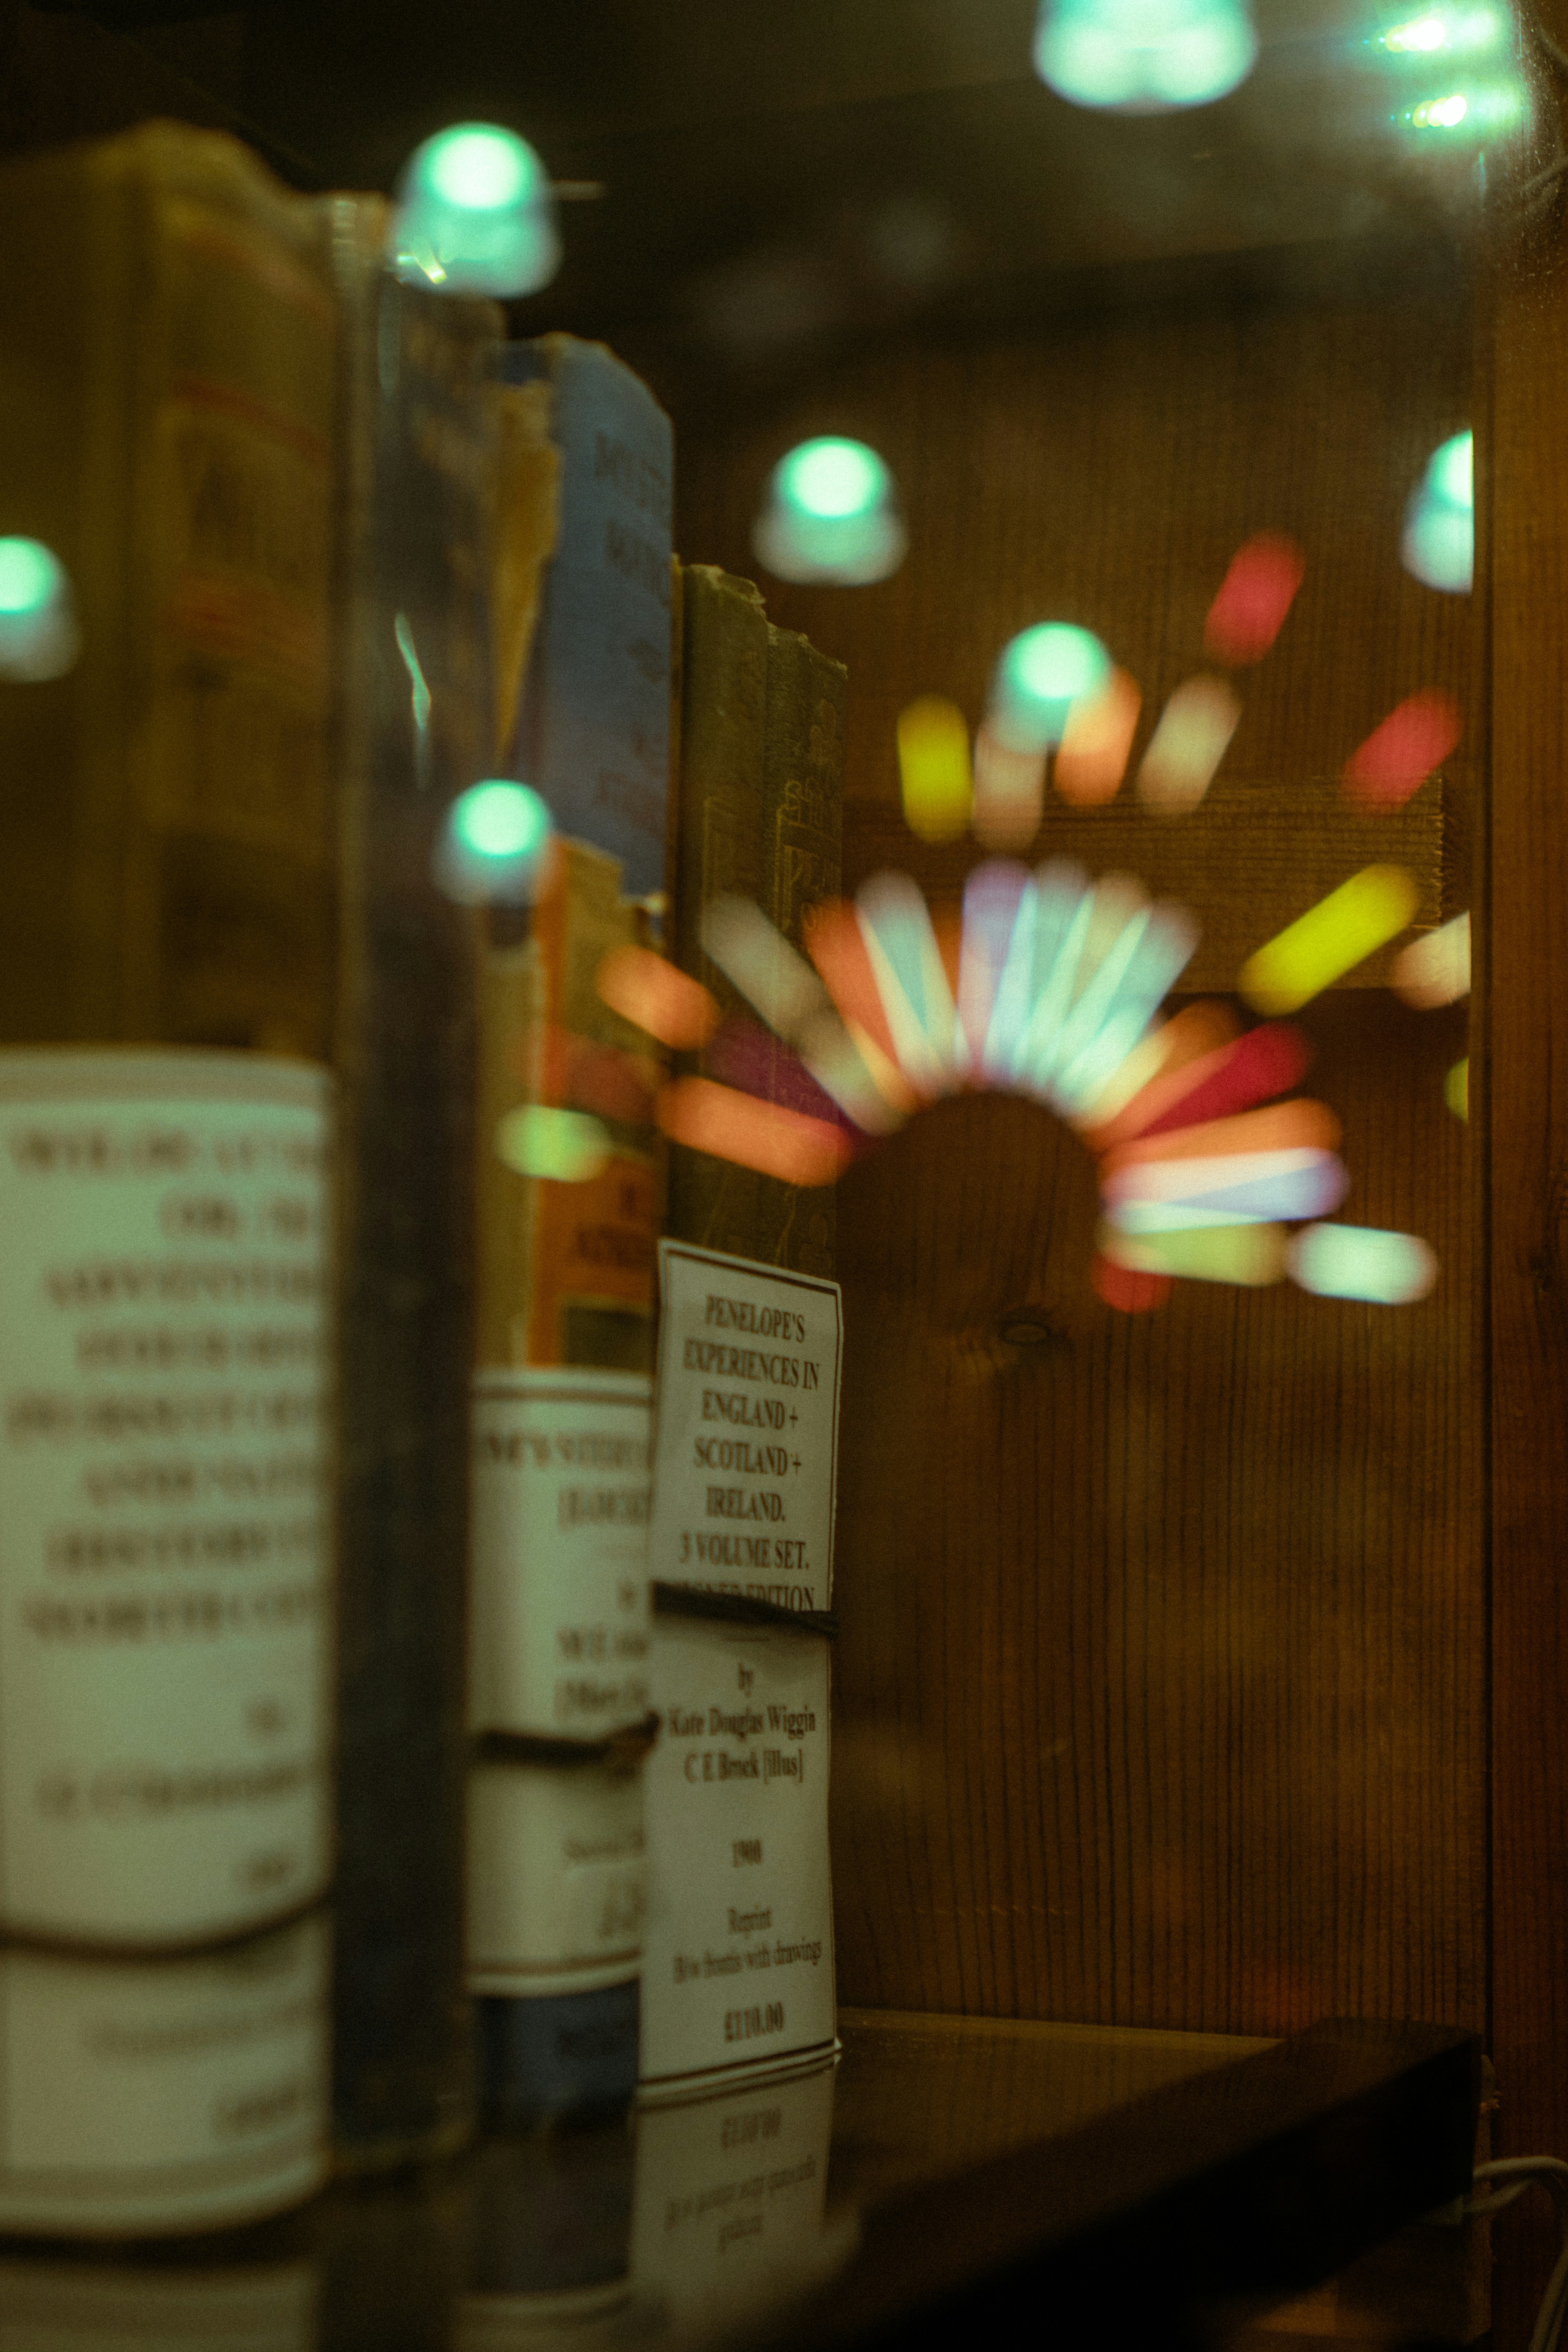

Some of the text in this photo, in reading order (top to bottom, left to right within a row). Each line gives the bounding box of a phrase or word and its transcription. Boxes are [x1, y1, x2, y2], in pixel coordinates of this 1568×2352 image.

[705, 1294, 805, 1343] PENELOPE'S
[684, 1338, 819, 1391] EXPERIENCES IN
[702, 1389, 785, 1430] ENGLAND
[694, 1437, 788, 1476] SCOTLAND
[706, 1485, 786, 1522] IRELAND.
[679, 1530, 810, 1569] 3 VOLUME SET.
[738, 1663, 753, 1697] by
[669, 1705, 816, 1742] Kate Douglas Wiggin
[684, 1750, 698, 1784] C
[718, 1751, 760, 1781] Brock
[744, 1943, 771, 1969] with
[774, 1937, 822, 1966] drawings
